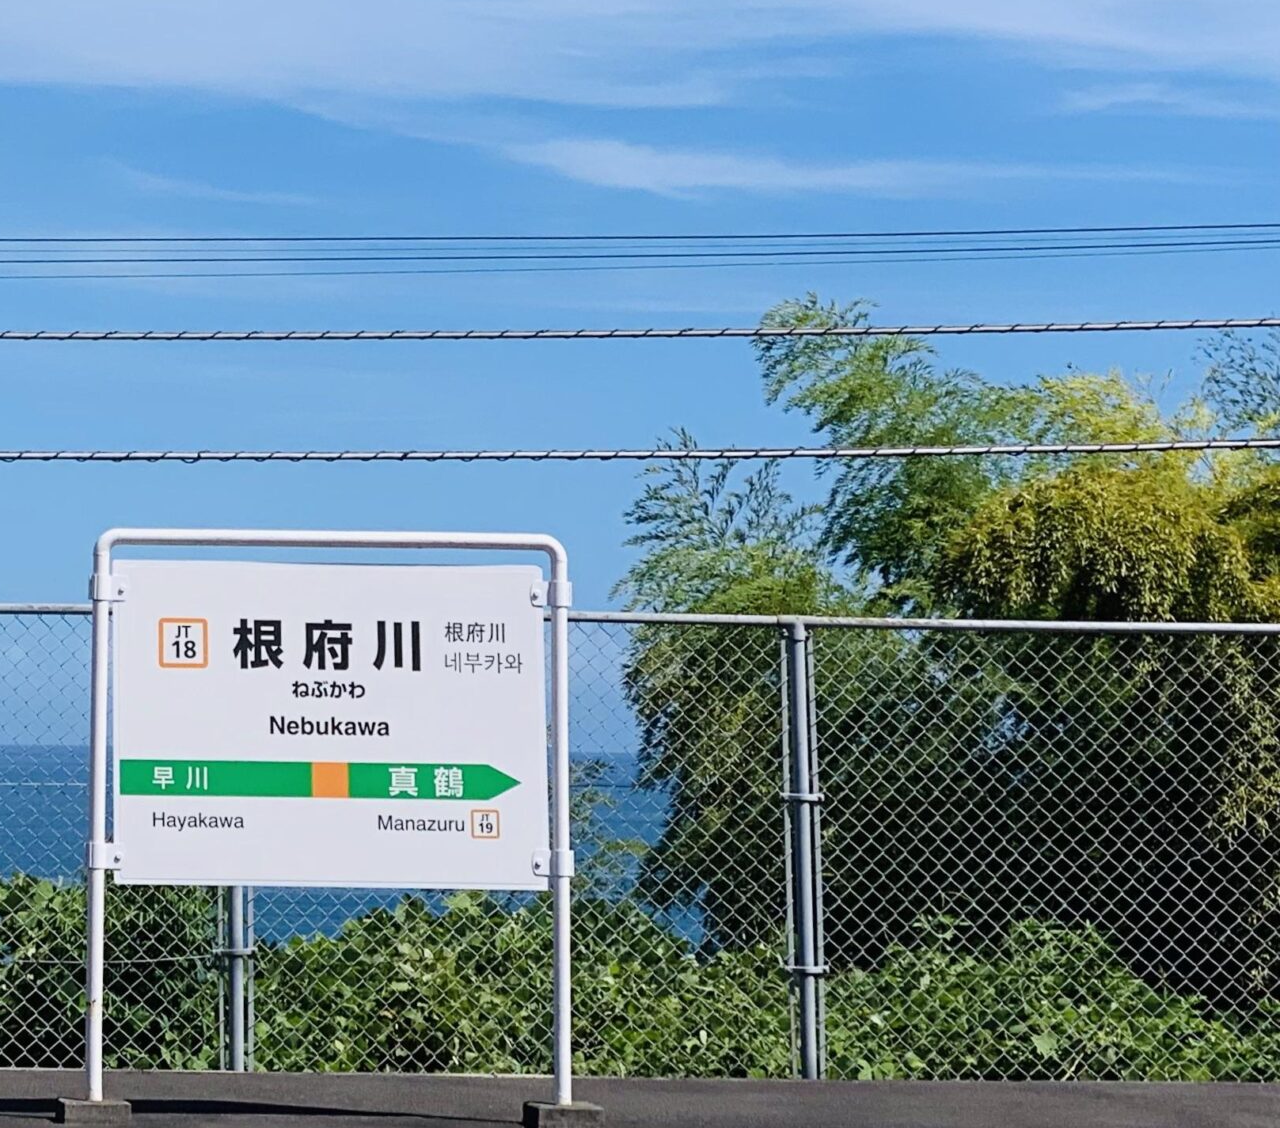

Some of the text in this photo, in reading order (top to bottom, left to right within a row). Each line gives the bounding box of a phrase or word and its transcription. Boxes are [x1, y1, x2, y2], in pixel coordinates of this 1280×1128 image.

[174, 624, 192, 639] JT
[443, 620, 506, 645] 根府川
[171, 639, 197, 659] 18
[232, 617, 422, 672] 根府川
[443, 651, 524, 675] 네부카와
[291, 680, 366, 700] ねぶかわ
[269, 715, 390, 737] Nebukawa
[152, 766, 209, 791] 早川
[388, 766, 465, 798] 真鶴
[152, 811, 245, 831] Hayakawa
[377, 814, 466, 833] Manazuru
[480, 813, 490, 823] JT
[478, 822, 494, 835] 19
